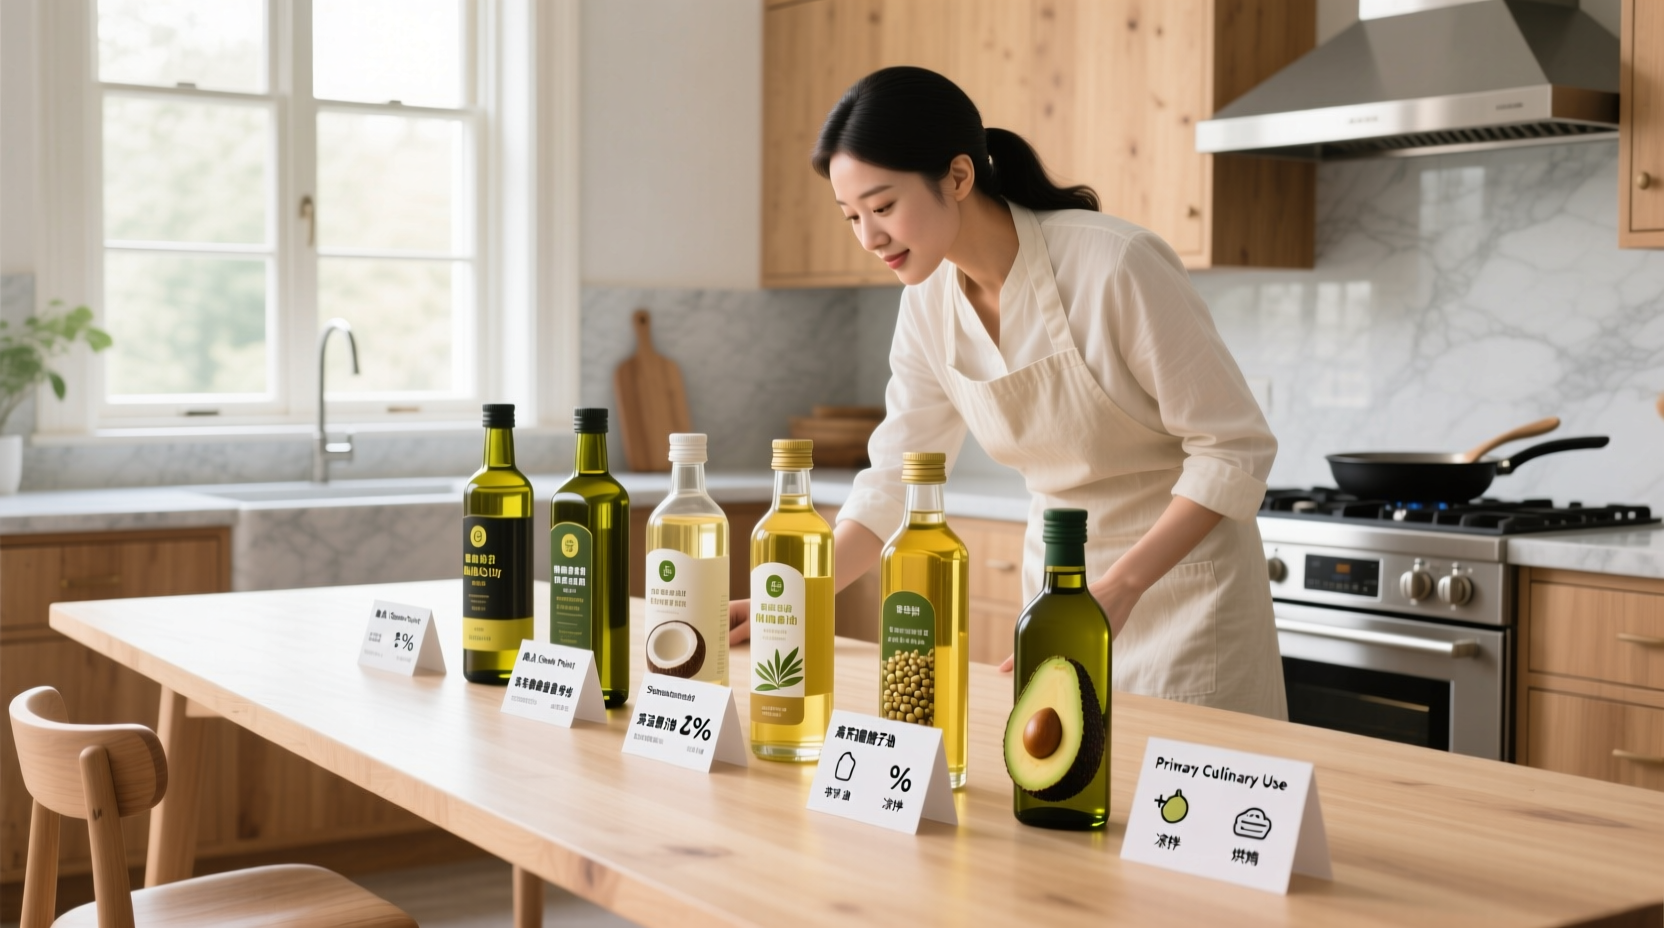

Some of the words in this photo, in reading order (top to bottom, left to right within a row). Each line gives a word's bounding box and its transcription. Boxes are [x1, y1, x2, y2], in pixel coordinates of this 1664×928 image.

[889, 764, 912, 793] %
[1202, 764, 1259, 789] Culinary
[1262, 773, 1288, 791] Use
